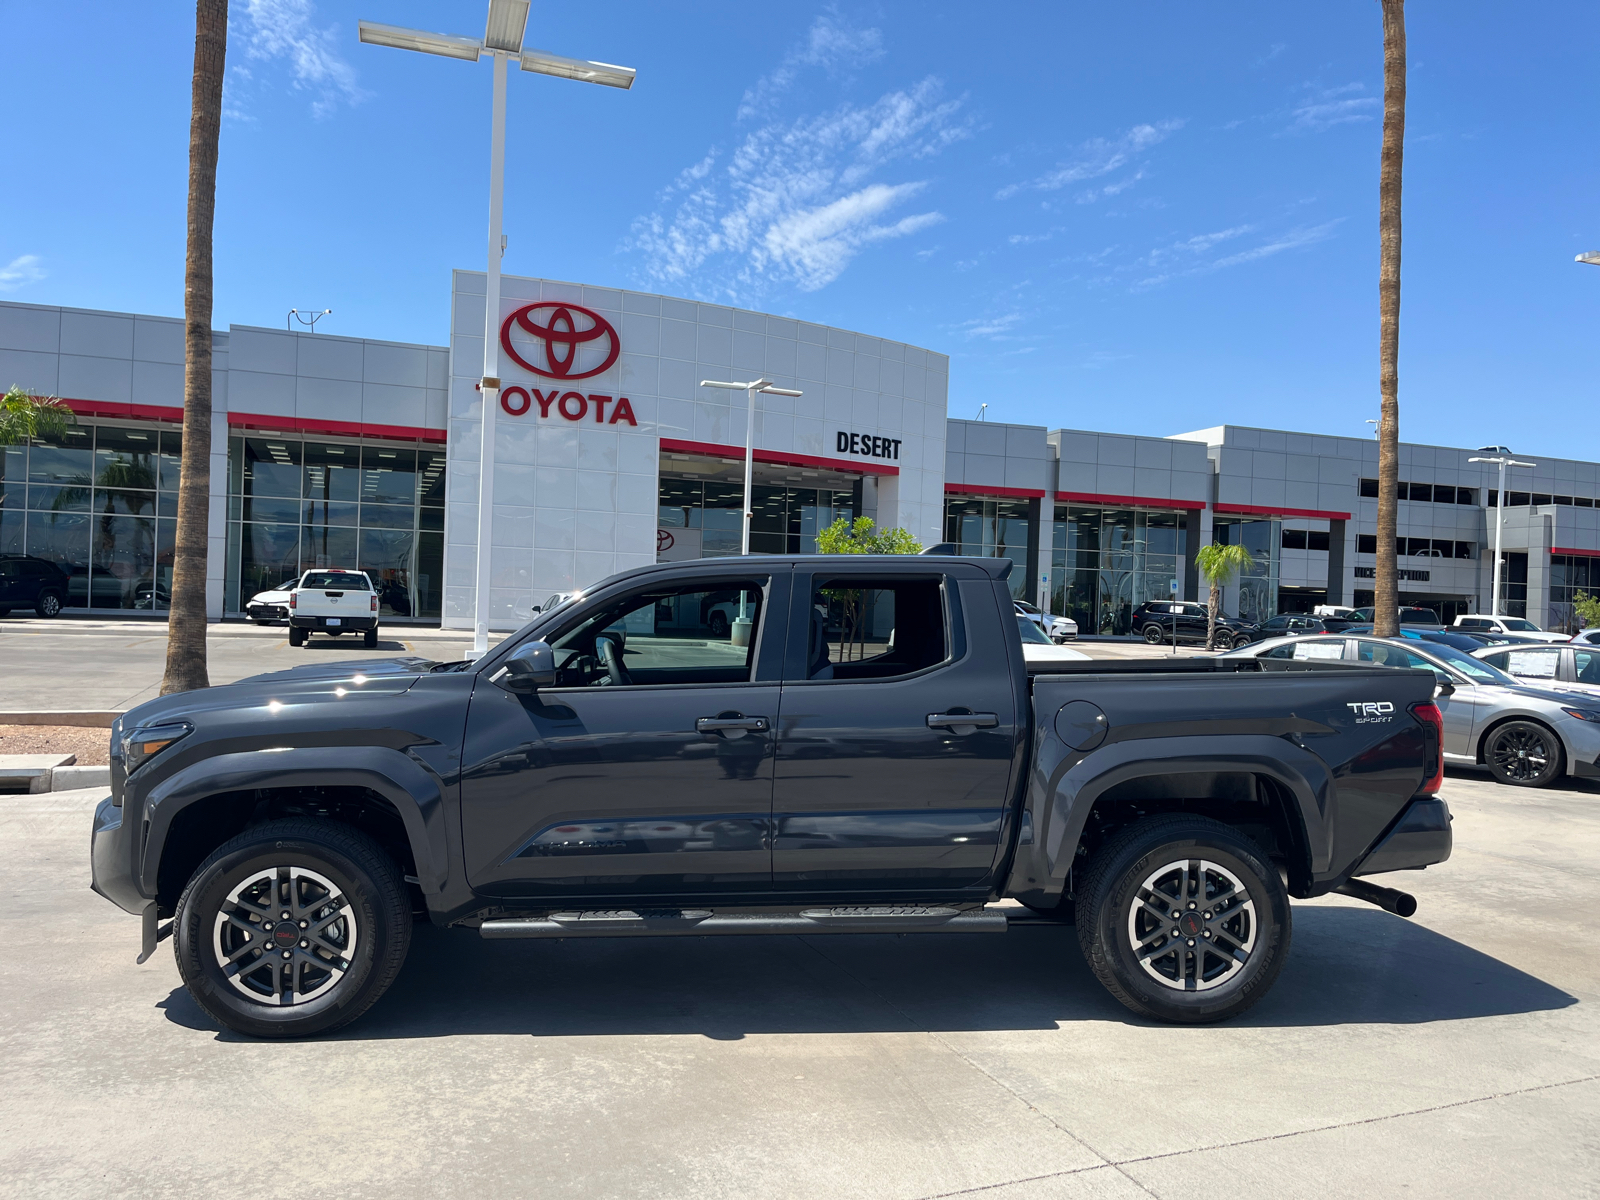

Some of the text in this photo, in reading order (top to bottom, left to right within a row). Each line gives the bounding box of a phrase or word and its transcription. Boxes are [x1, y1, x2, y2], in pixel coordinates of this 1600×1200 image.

[475, 383, 638, 426] OYOTA
[837, 431, 902, 459] DESERT
[1354, 567, 1430, 582] VICE EPTION
[1346, 701, 1396, 717] TRD
[1115, 858, 1150, 905] MICHELIN
[1242, 947, 1275, 994] MICHELIN
